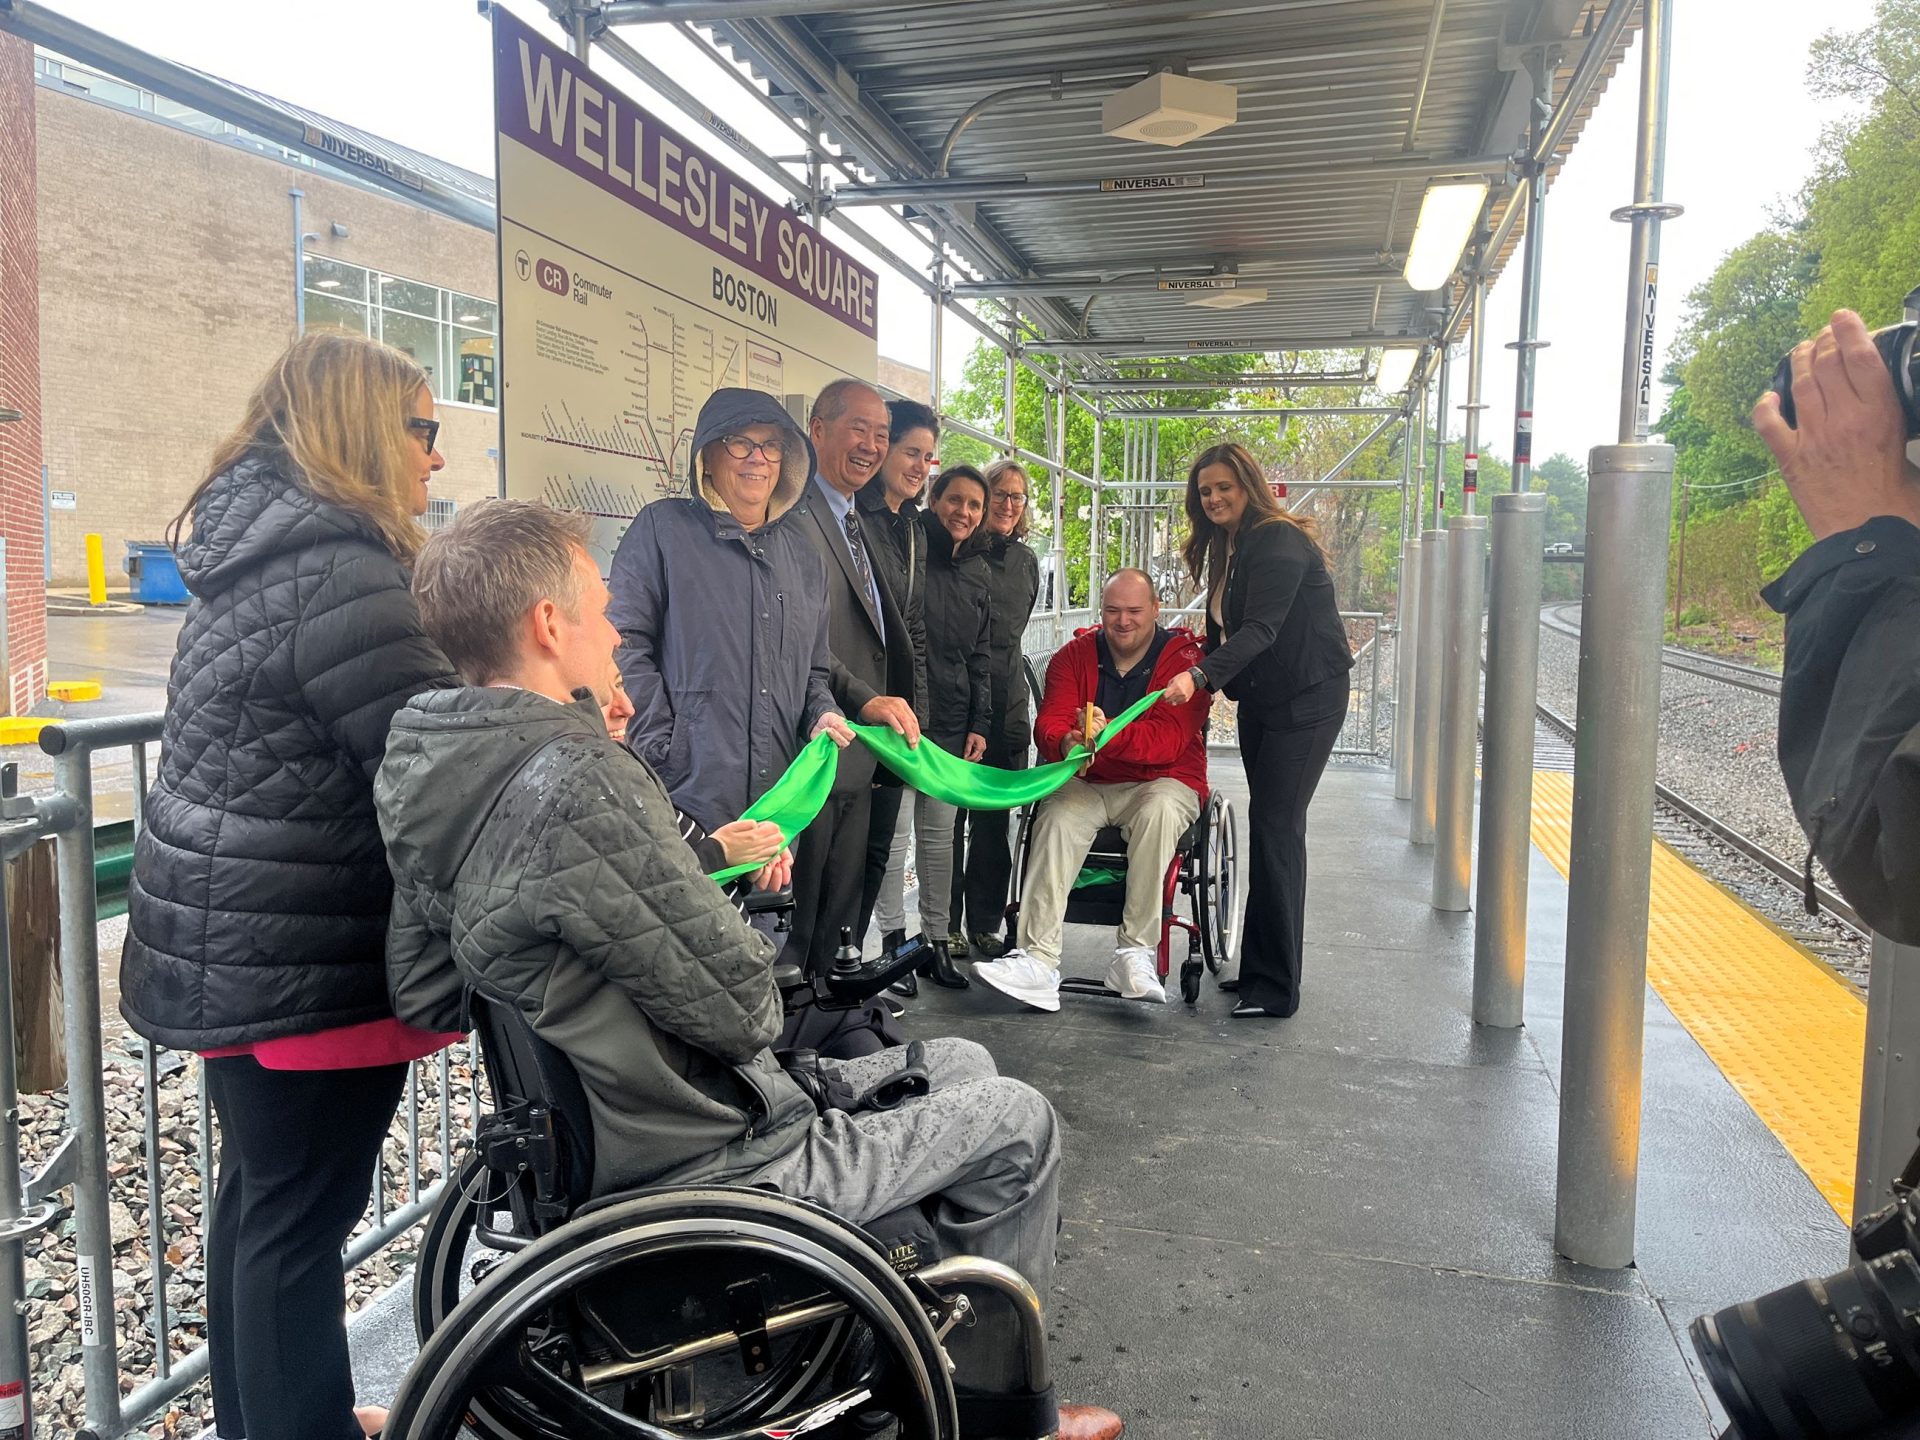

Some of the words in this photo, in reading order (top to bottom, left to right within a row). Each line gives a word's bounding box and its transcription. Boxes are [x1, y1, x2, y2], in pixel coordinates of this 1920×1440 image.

[518, 38, 769, 263] WELLESLEY
[777, 219, 873, 328] SQUARE
[543, 265, 562, 290] CR
[573, 272, 612, 300] Commuter
[573, 288, 588, 306] Rail
[712, 266, 777, 327] BOSTON
[80, 1267, 94, 1335] UH50GR-IBC
